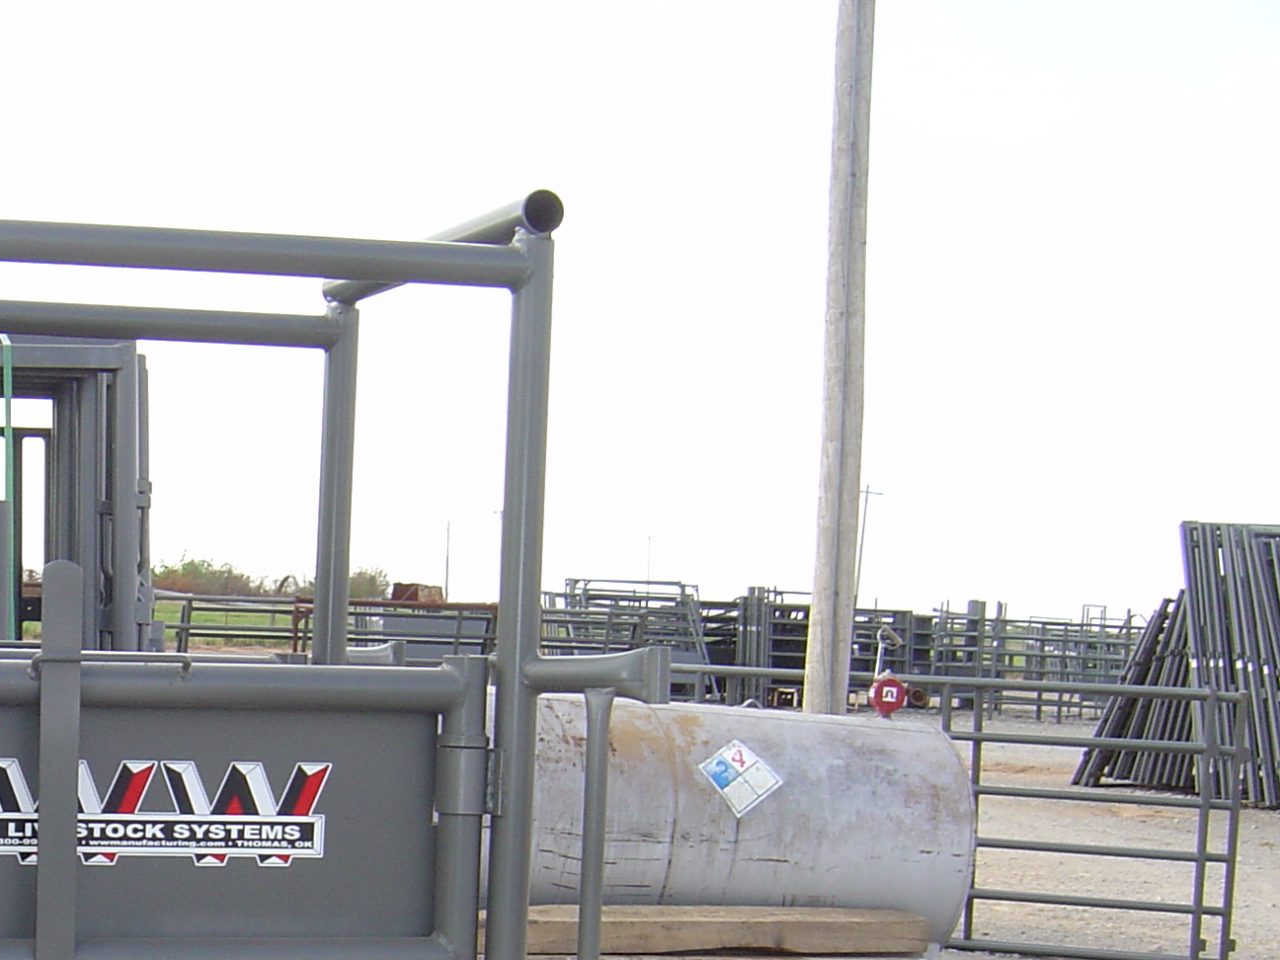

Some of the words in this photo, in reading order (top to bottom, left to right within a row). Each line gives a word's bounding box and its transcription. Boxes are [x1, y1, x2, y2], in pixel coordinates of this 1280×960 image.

[8, 821, 164, 838] LISTOCK
[173, 823, 301, 840] SYSTEMS
[89, 840, 225, 849] wwmanufacturing.com
